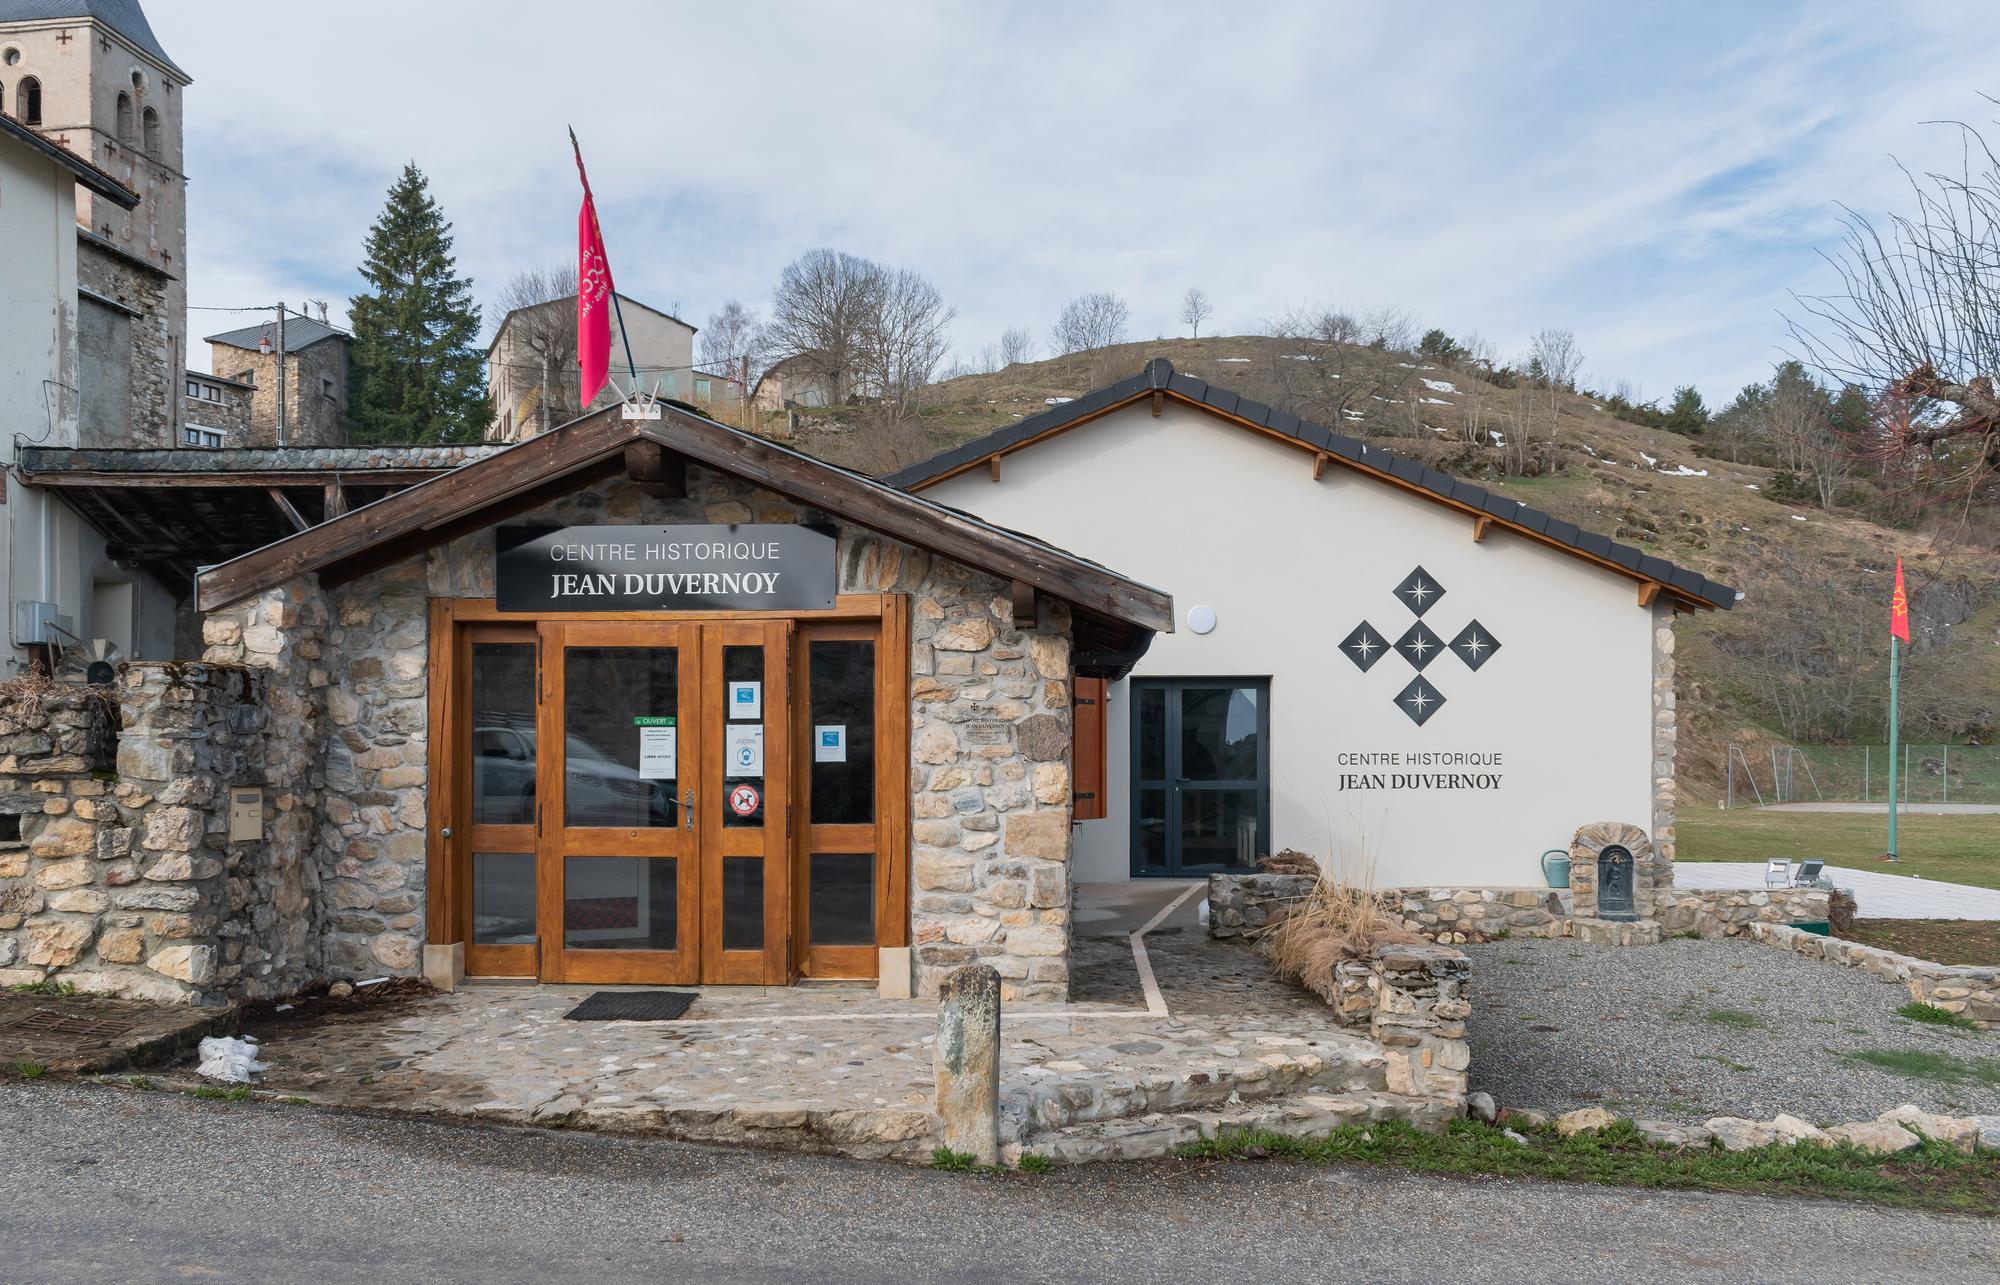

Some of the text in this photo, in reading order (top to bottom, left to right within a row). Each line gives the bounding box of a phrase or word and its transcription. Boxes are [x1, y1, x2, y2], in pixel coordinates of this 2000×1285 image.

[550, 542, 780, 562] CENTRE HISTORIQUE
[551, 572, 780, 598] JEAN DUVERNOY
[1338, 753, 1503, 766] CENTRE HISTORIQUE
[1338, 774, 1503, 791] JEAN DUVERNOY
